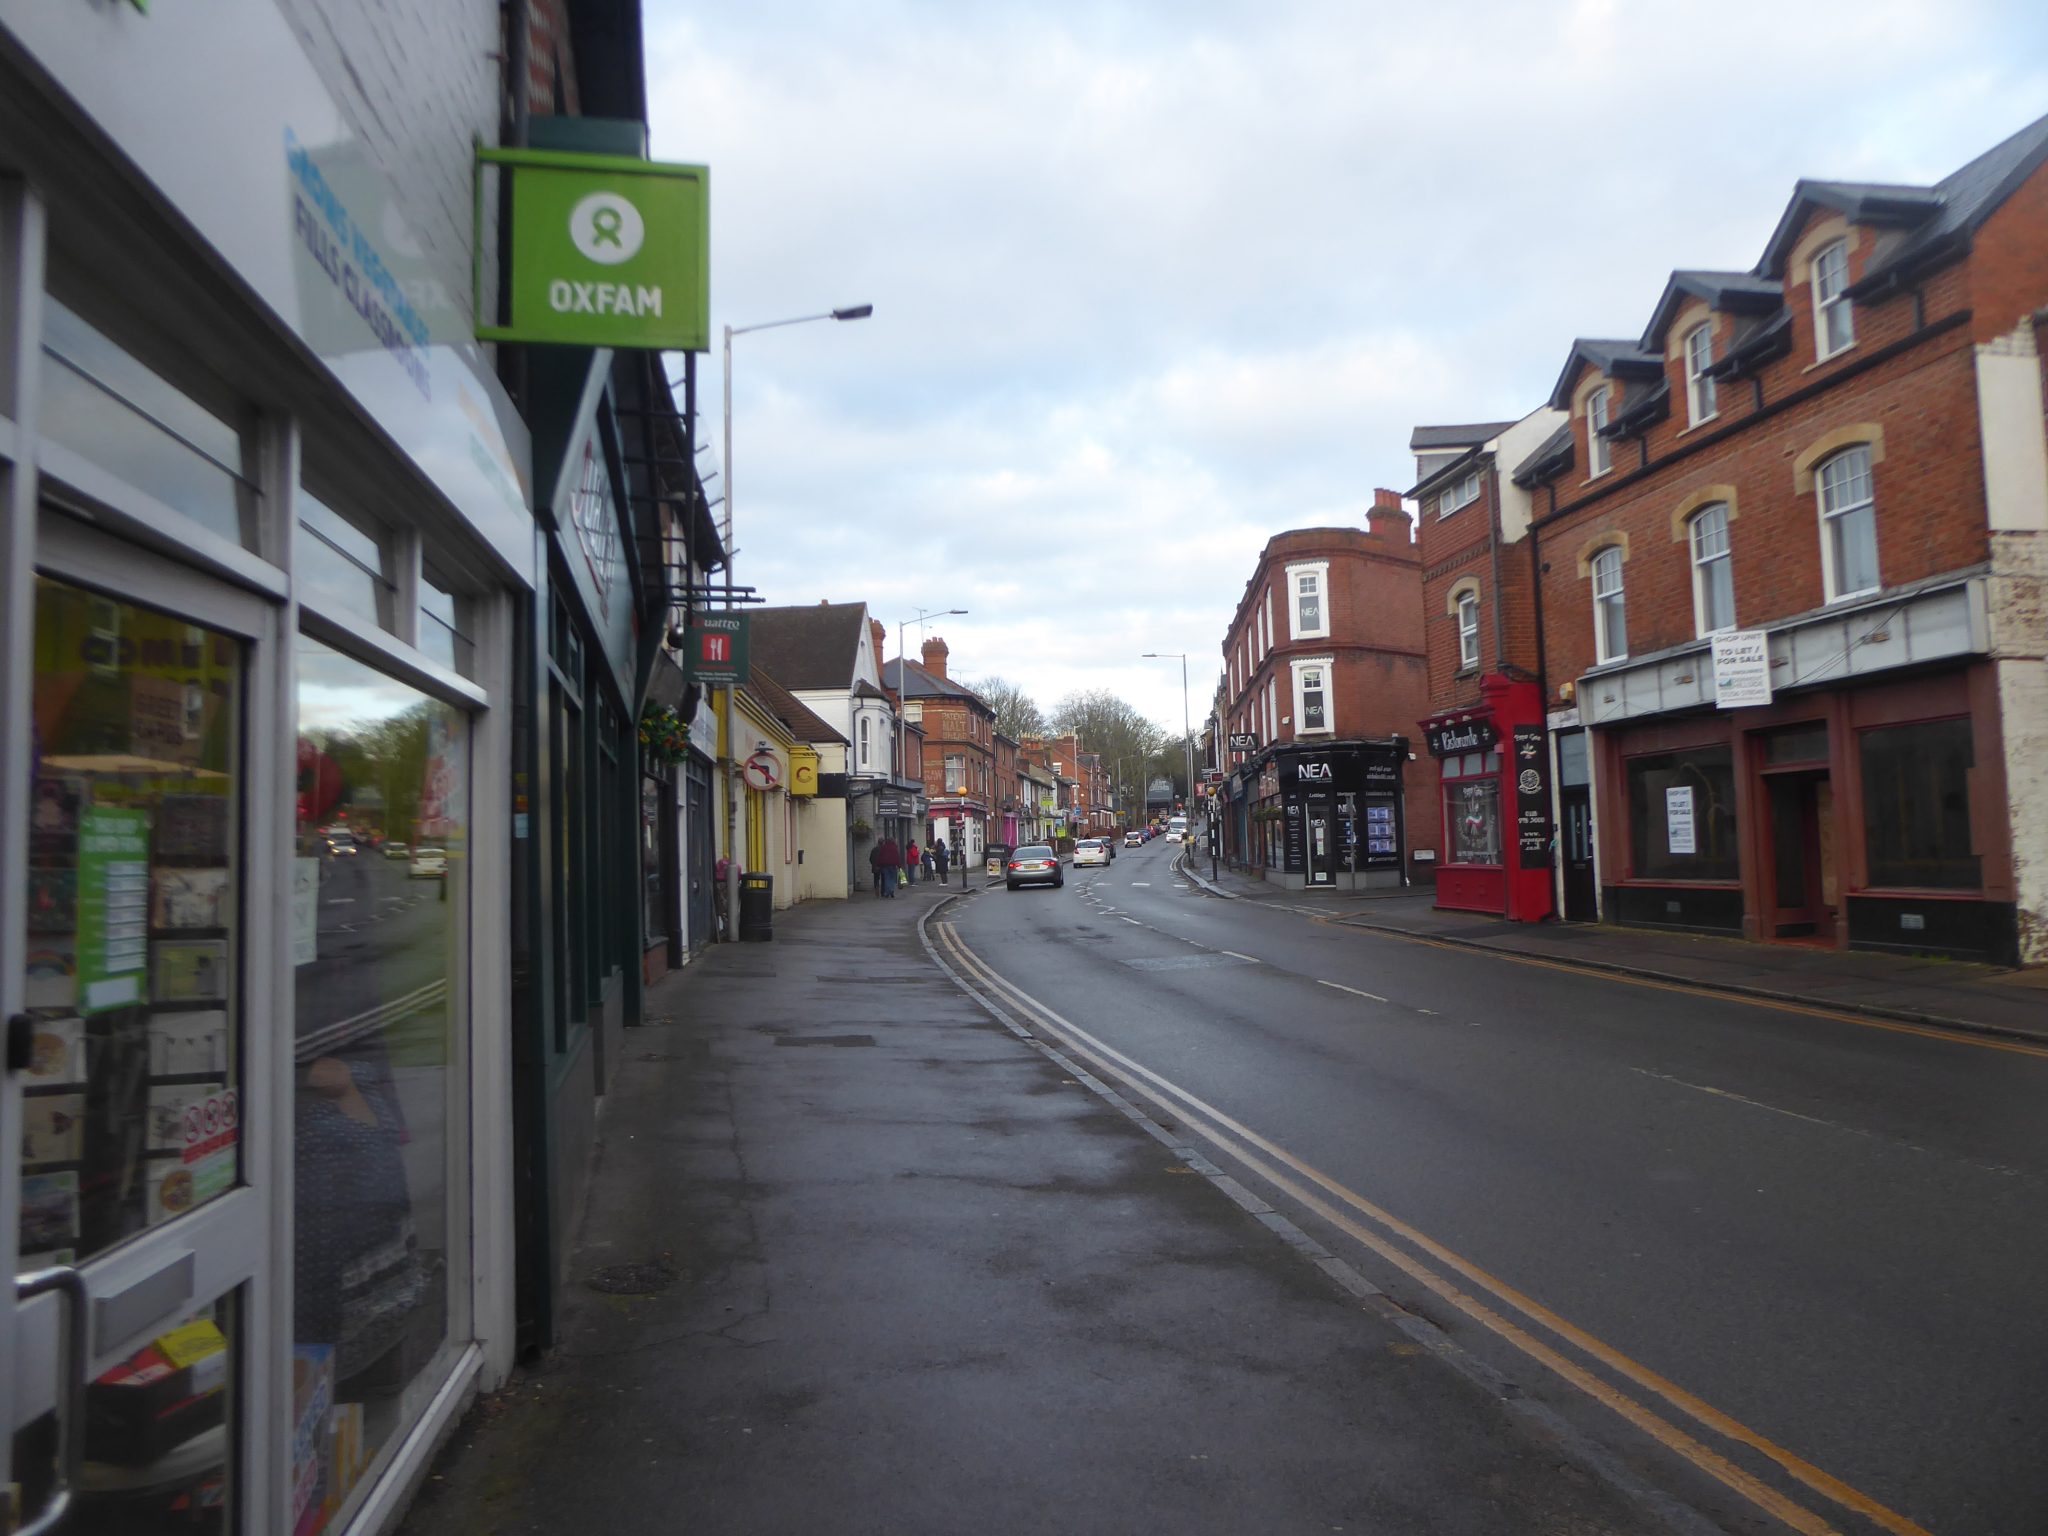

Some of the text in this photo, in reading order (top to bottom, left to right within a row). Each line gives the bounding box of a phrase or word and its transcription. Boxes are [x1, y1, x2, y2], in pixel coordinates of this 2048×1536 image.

[549, 279, 662, 318] OXFAM
[1301, 607, 1319, 617] NEA
[1719, 648, 1733, 656] TO
[1735, 646, 1753, 655] LET
[1717, 655, 1764, 665] FOR SALE
[1305, 705, 1324, 715] NEA
[941, 712, 967, 720] PATENT
[942, 720, 967, 731] MALT
[1229, 735, 1255, 747] NEA
[1441, 726, 1479, 751] Ristorante
[1298, 763, 1332, 778] NEA
[1310, 819, 1326, 828] NEA
